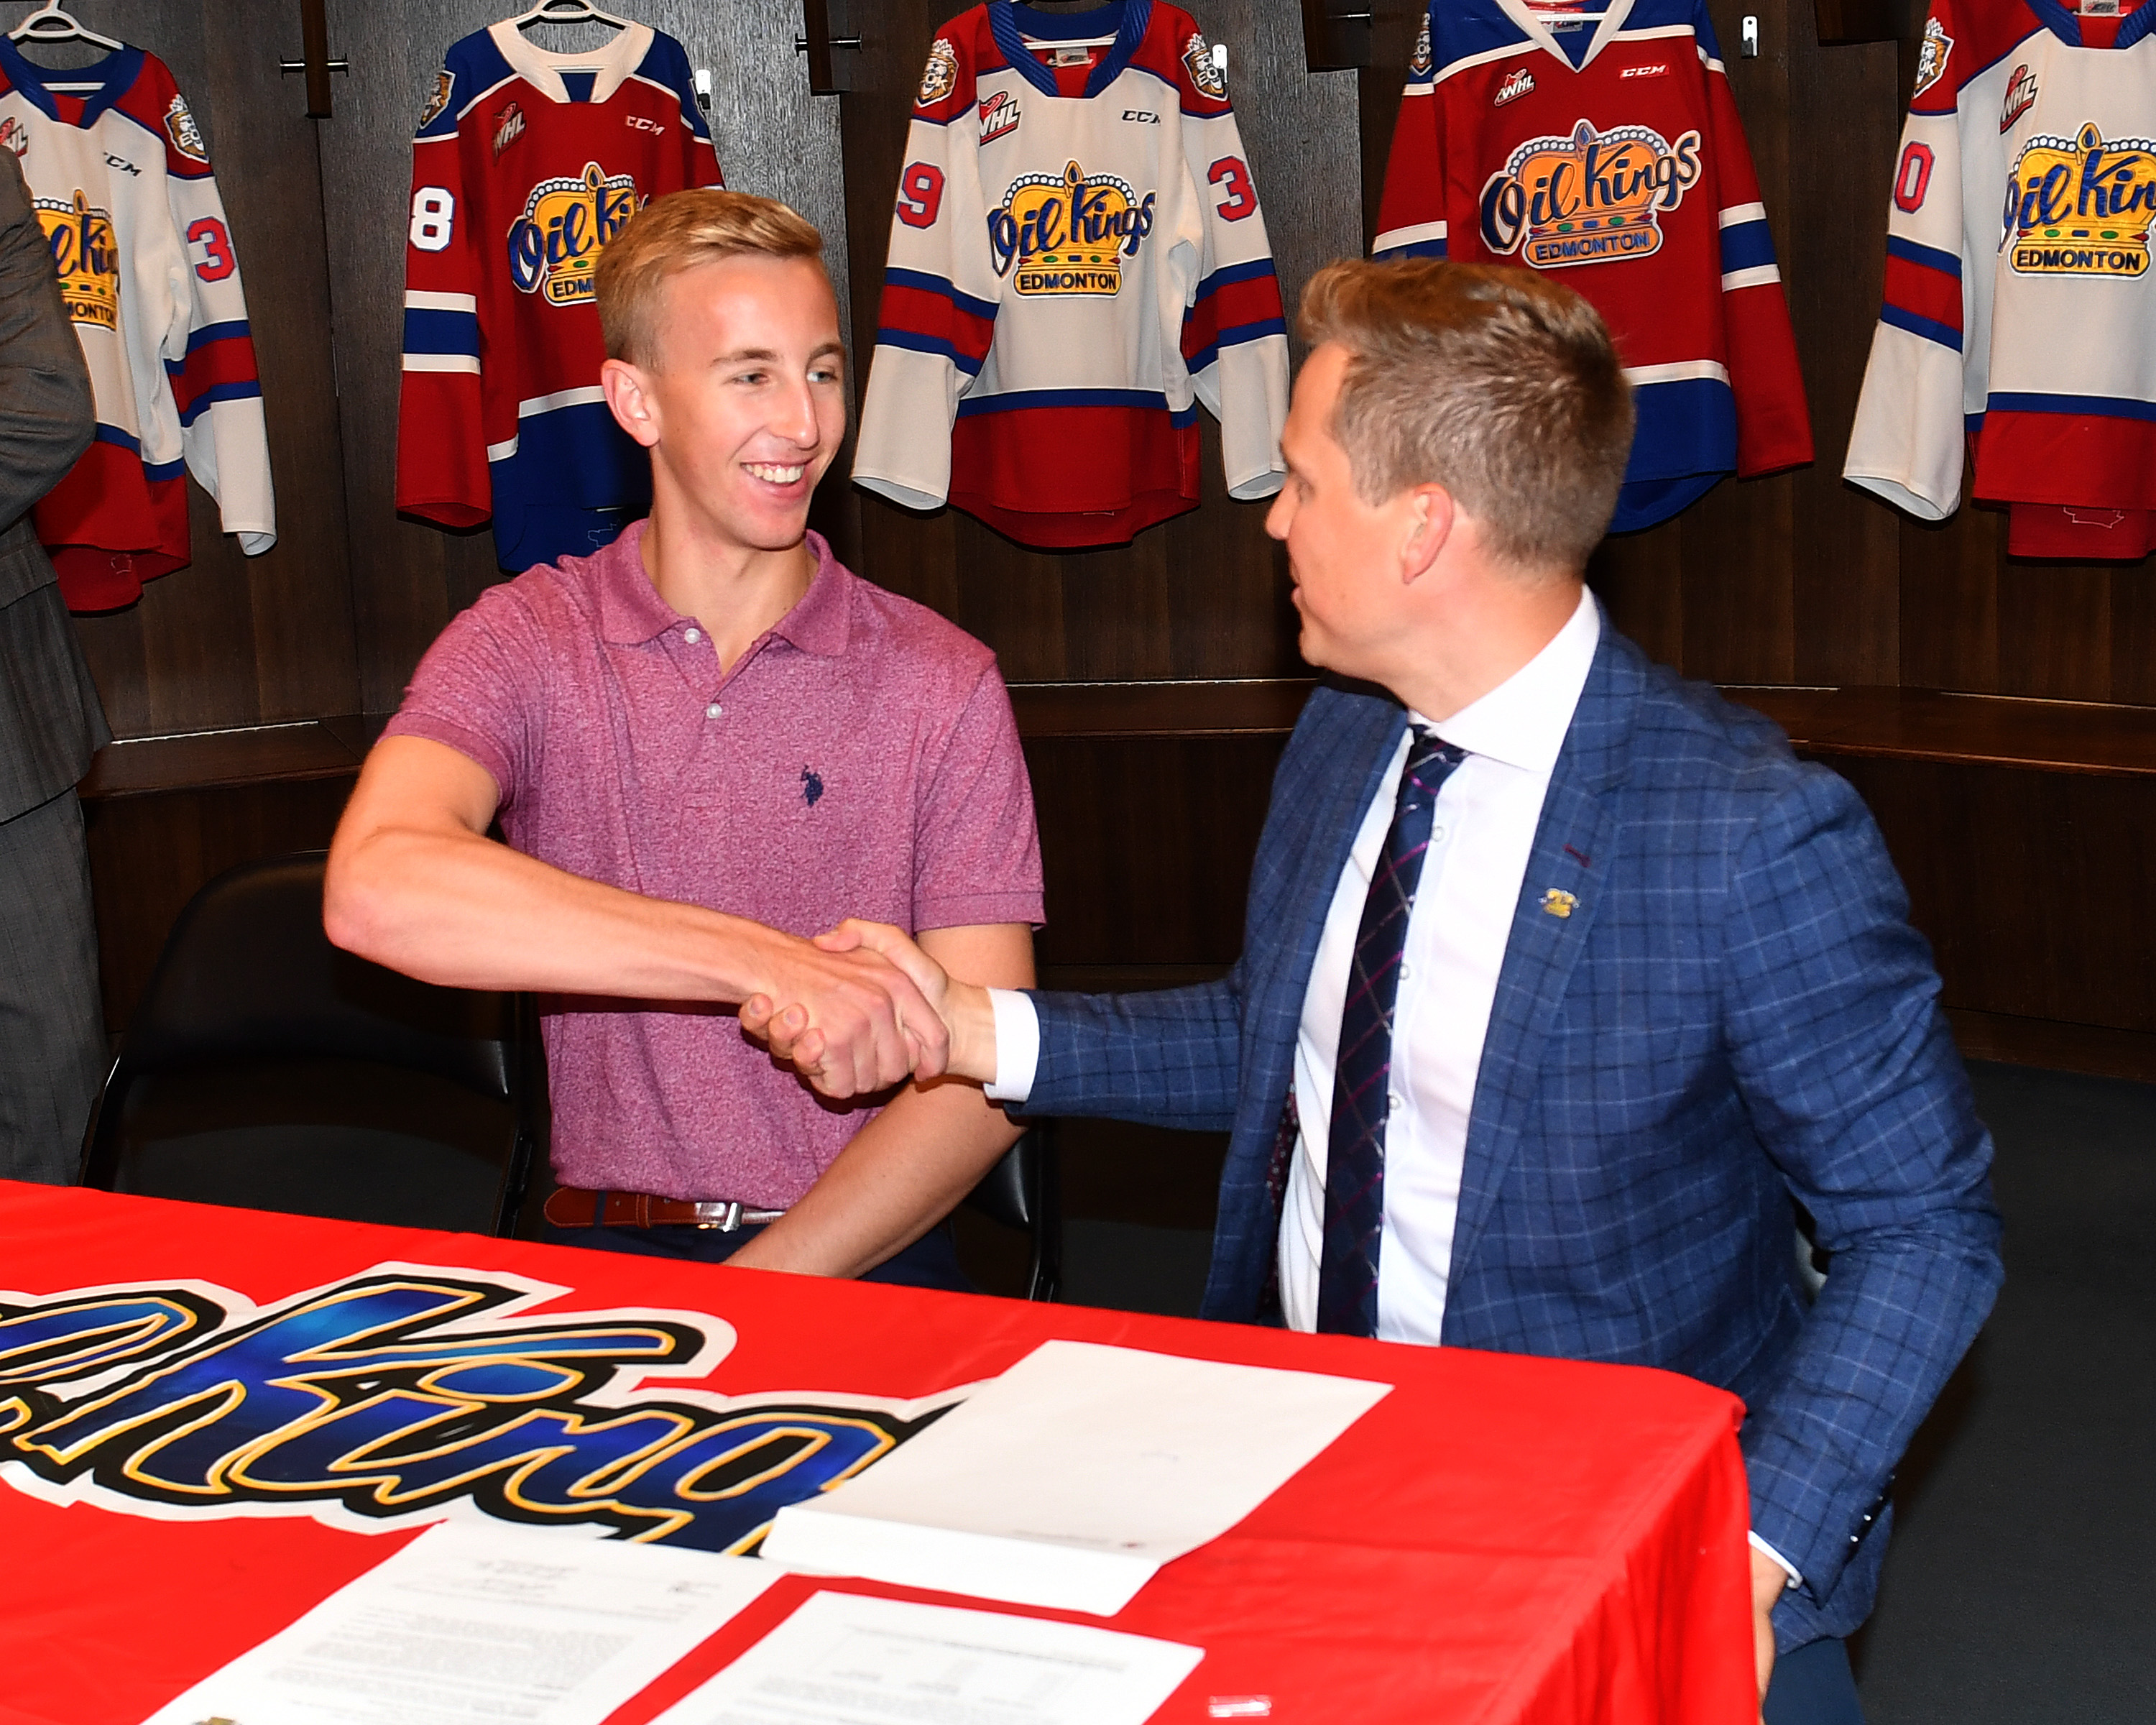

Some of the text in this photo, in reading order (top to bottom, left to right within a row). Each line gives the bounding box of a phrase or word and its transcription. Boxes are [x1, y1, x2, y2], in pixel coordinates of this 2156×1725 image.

[1196, 66, 1219, 86] EO
[1622, 65, 1666, 78] CCM
[1919, 58, 1937, 76] OK
[1502, 75, 1534, 99] WHL
[626, 115, 665, 136] CCM
[103, 152, 142, 178] CM
[896, 160, 946, 229] 9
[1208, 155, 1258, 222] 3
[2078, 149, 2156, 218] Kin
[409, 185, 456, 252] 8
[1481, 162, 1581, 249] Oil
[187, 216, 235, 283] 3
[1535, 231, 1650, 261] EDMONTON
[2017, 249, 2141, 271] EDMONTON
[1020, 272, 1118, 290] EDMONTON
[12, 1282, 898, 1558] King
